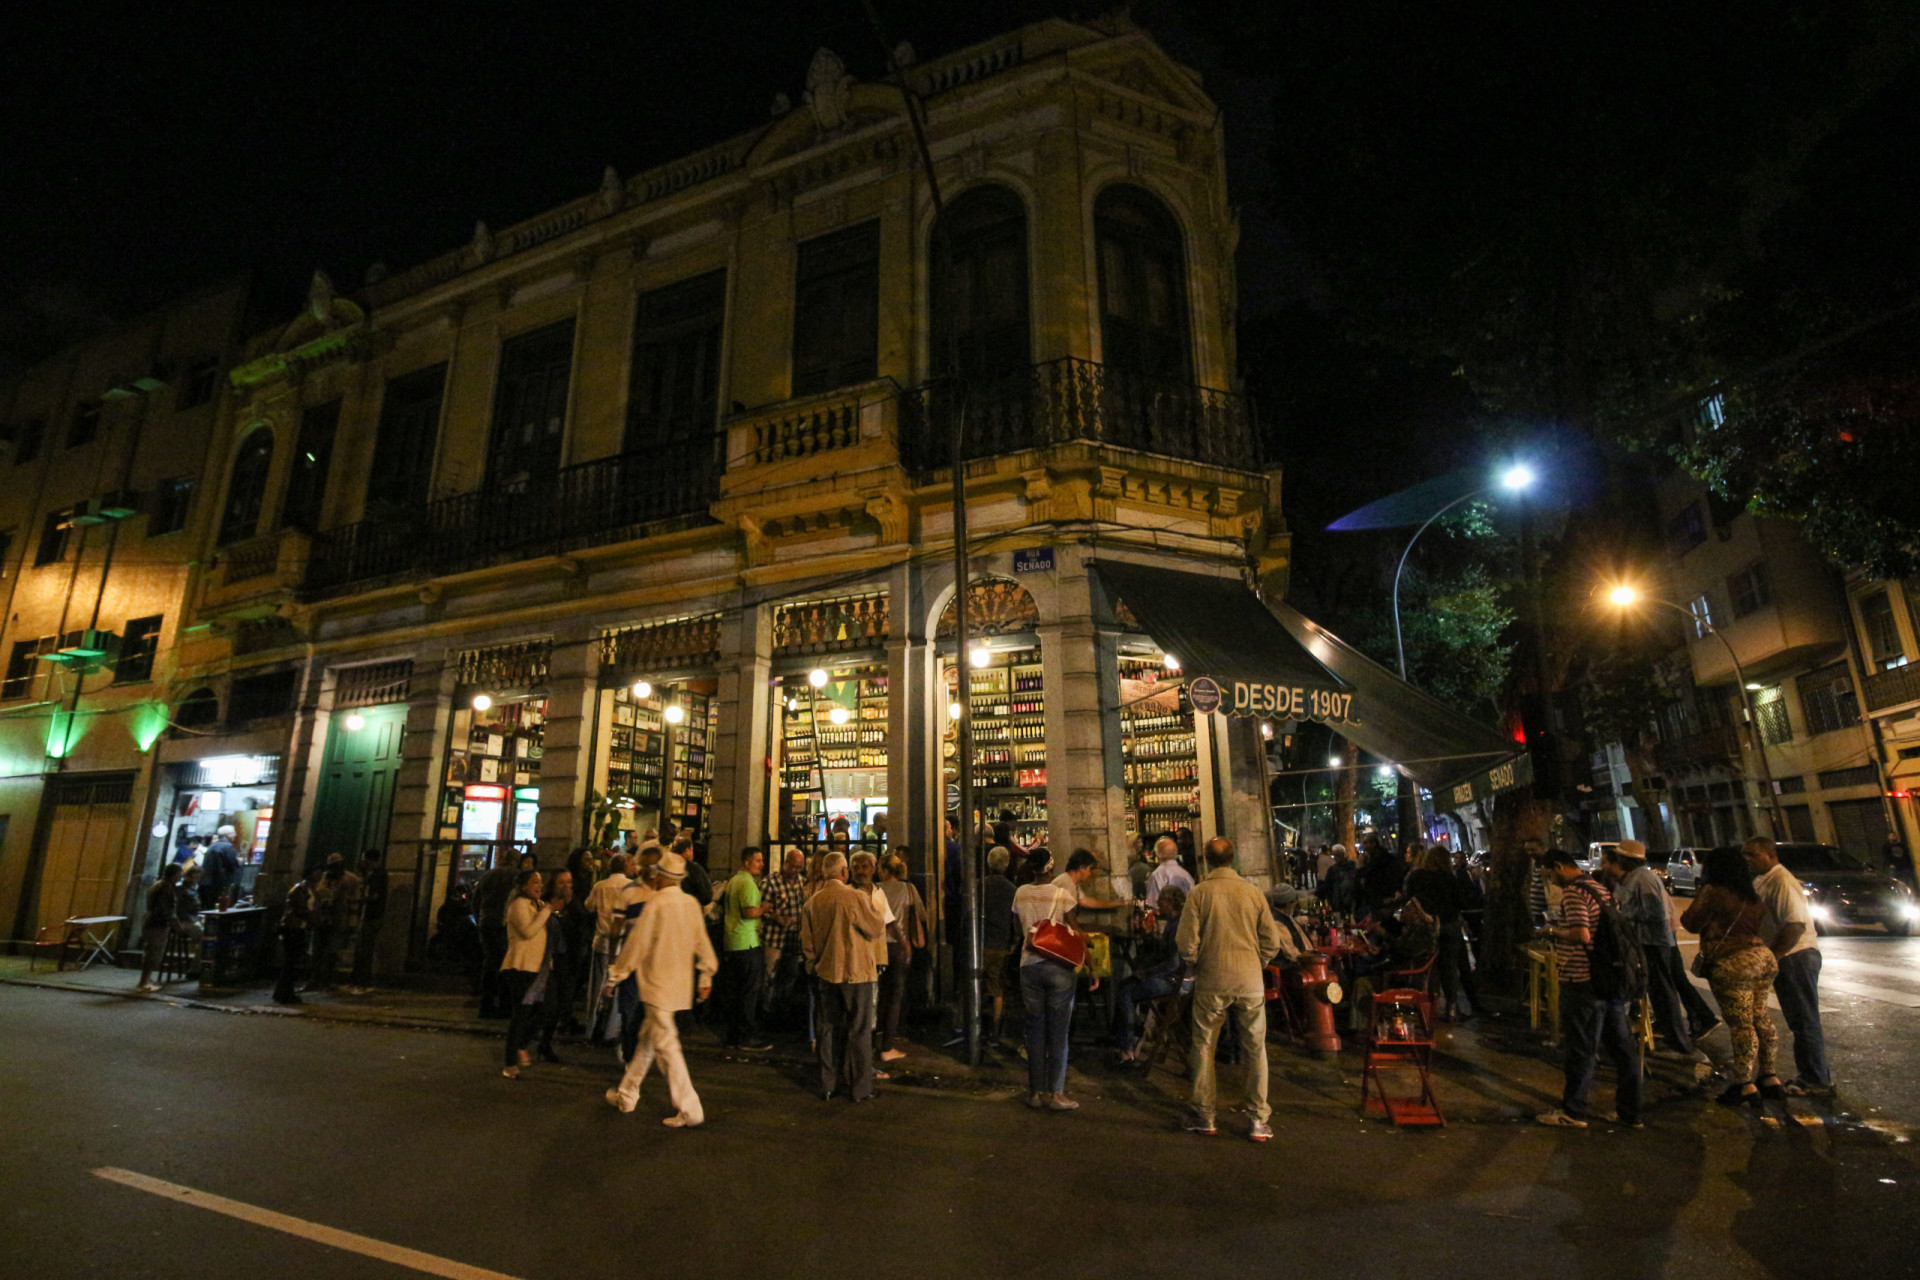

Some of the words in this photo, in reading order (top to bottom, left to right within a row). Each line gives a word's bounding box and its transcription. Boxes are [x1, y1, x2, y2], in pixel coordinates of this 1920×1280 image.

[1017, 560, 1051, 572] SENADO
[1235, 682, 1304, 713] DESDE
[1310, 689, 1352, 719] 1907
